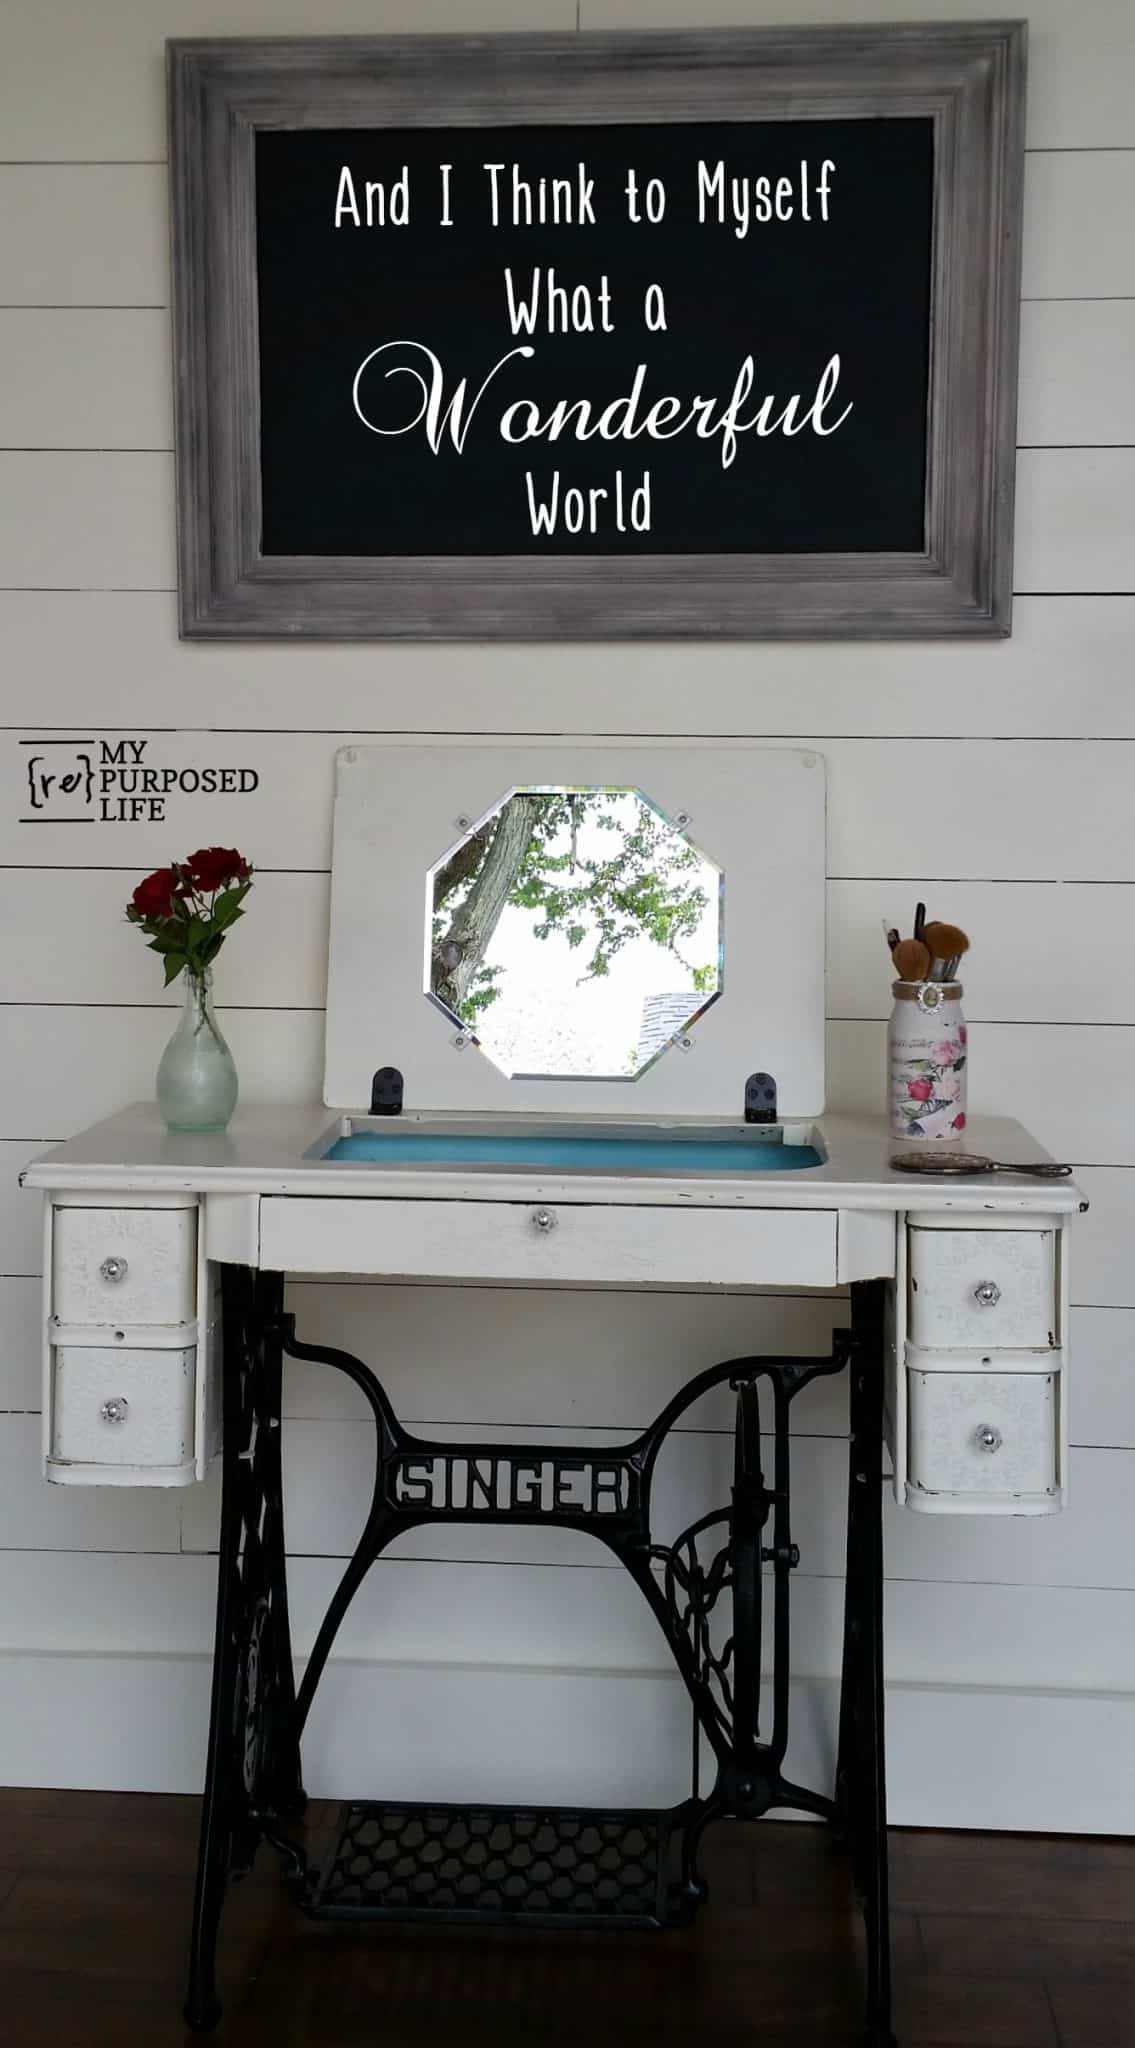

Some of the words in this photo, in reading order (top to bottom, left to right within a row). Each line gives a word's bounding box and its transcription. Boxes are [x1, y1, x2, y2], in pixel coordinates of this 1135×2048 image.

[335, 164, 410, 227] And
[440, 165, 453, 225] I
[484, 163, 595, 226] Think
[625, 169, 665, 223] to
[698, 160, 835, 238] Myself
[505, 268, 614, 334] What
[645, 284, 667, 331] a
[353, 341, 853, 469] Wonderful
[526, 471, 650, 535] World
[400, 1455, 627, 1513] SINGER
